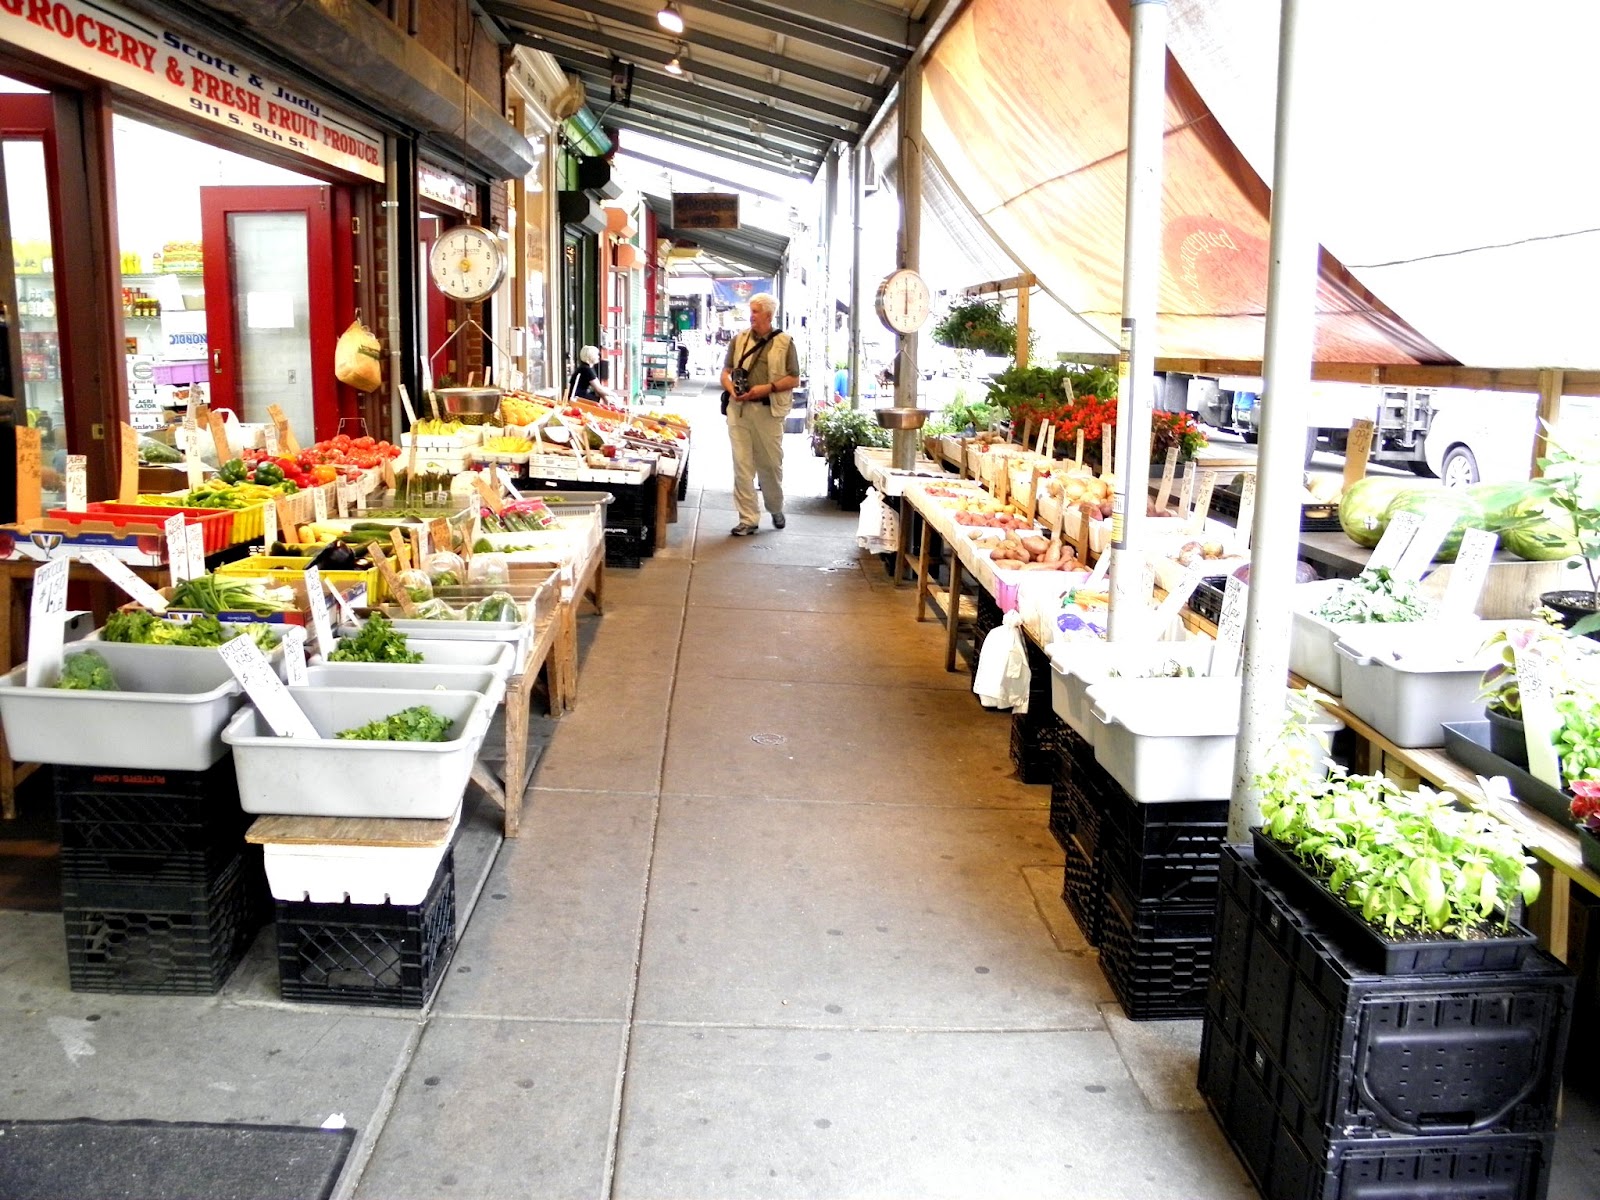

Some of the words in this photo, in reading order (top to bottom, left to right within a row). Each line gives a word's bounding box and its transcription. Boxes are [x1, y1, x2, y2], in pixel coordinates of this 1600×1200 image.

[163, 31, 240, 78] Scott
[248, 74, 265, 90] &
[272, 87, 320, 118] Judy
[165, 56, 185, 87] &
[190, 66, 261, 119] FRESH
[267, 101, 319, 140] FRUIT
[323, 125, 379, 166] PRODUCE
[189, 97, 220, 117] 911
[228, 113, 244, 126] S.
[252, 122, 283, 141] 9th
[289, 136, 309, 151] St.
[1180, 228, 1239, 268] accepted
